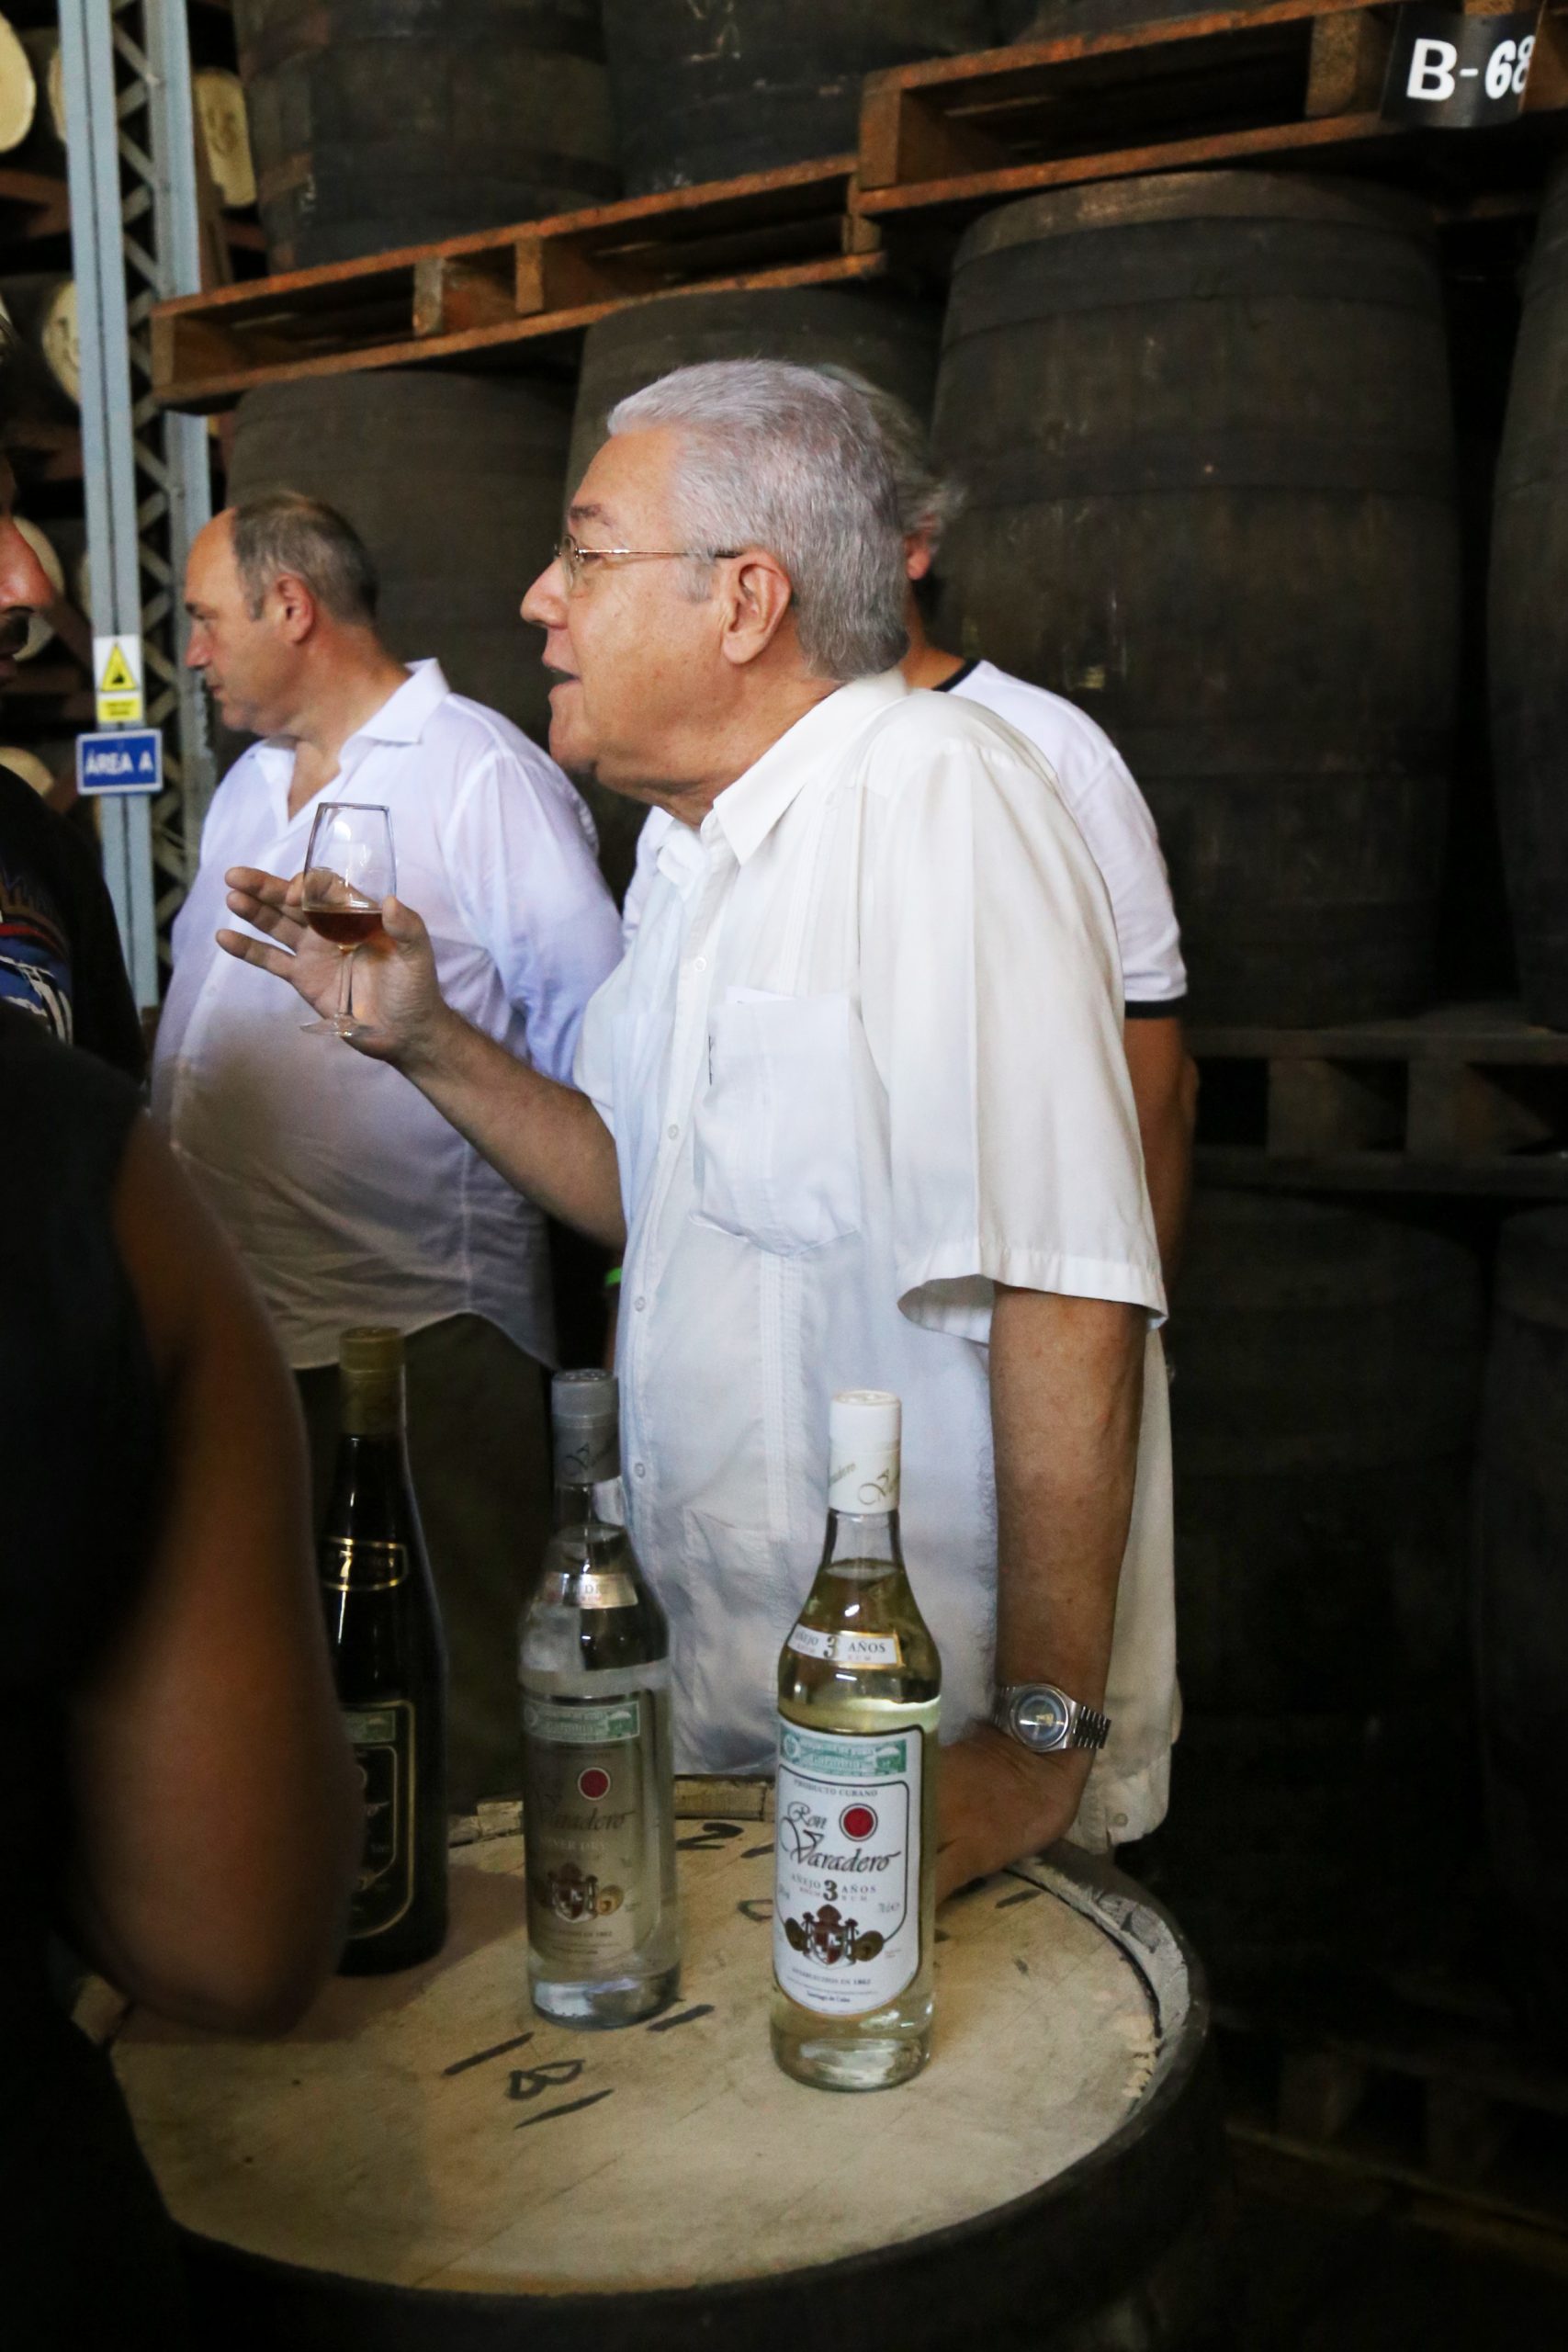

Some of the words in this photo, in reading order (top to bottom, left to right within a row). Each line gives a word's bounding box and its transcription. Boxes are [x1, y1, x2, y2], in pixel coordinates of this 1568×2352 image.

[1406, 35, 1535, 101] B-68
[139, 751, 153, 772] A
[823, 1635, 839, 1659] 3
[849, 1640, 886, 1654] AÑOS
[838, 1788, 878, 1797] CUBANO
[787, 1801, 827, 1829] Ron
[779, 1815, 901, 1872] Varadero
[822, 1879, 839, 1902] 3
[841, 1883, 877, 1894] AÑOS
